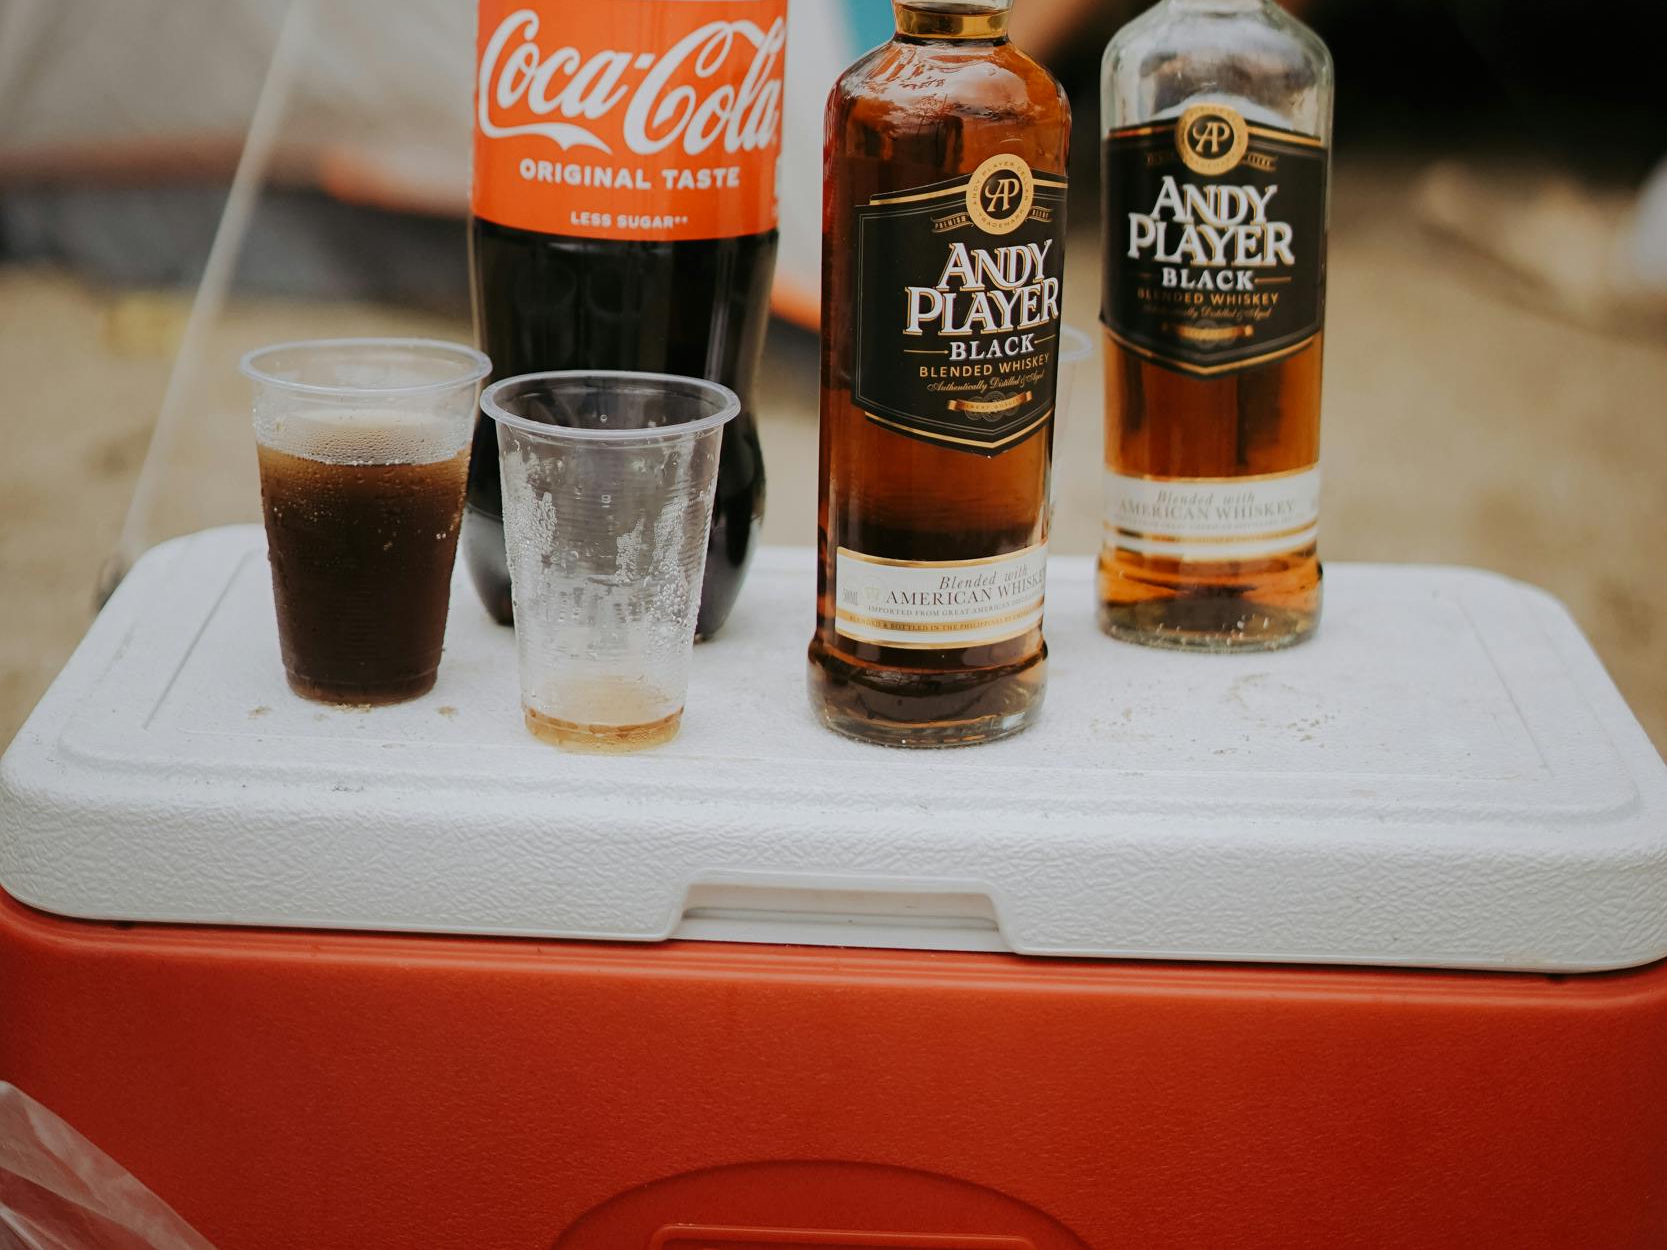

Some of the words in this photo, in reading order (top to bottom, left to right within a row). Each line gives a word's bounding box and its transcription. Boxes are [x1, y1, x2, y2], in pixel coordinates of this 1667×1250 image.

[478, 8, 787, 156] Coca-Cola
[518, 158, 651, 191] ORIGINAL
[662, 166, 741, 191] TASTE
[1149, 175, 1279, 229] ANDY
[570, 210, 612, 229] LESS
[934, 214, 967, 230] PREMIUM
[1126, 212, 1296, 267] PLAYER
[937, 238, 1053, 293] ANDY
[1161, 267, 1255, 291] BLACK
[902, 277, 1060, 336] PLAYER
[1210, 291, 1280, 306] WHISKEY
[948, 333, 1036, 361] BLACK
[920, 364, 993, 378] BLENDED
[998, 352, 1050, 374] WHISKEY
[927, 379, 988, 393] Authentically
[1118, 499, 1210, 521] AMERICAN
[1215, 500, 1297, 521] WHISKEY
[886, 588, 992, 606] AMERICAN
[998, 568, 1045, 598] WHISKE
[939, 571, 997, 591] Blended
[1004, 563, 1028, 583] with
[868, 605, 913, 616] IMPORTED
[915, 609, 940, 617] FROM
[941, 608, 969, 617] GREAT
